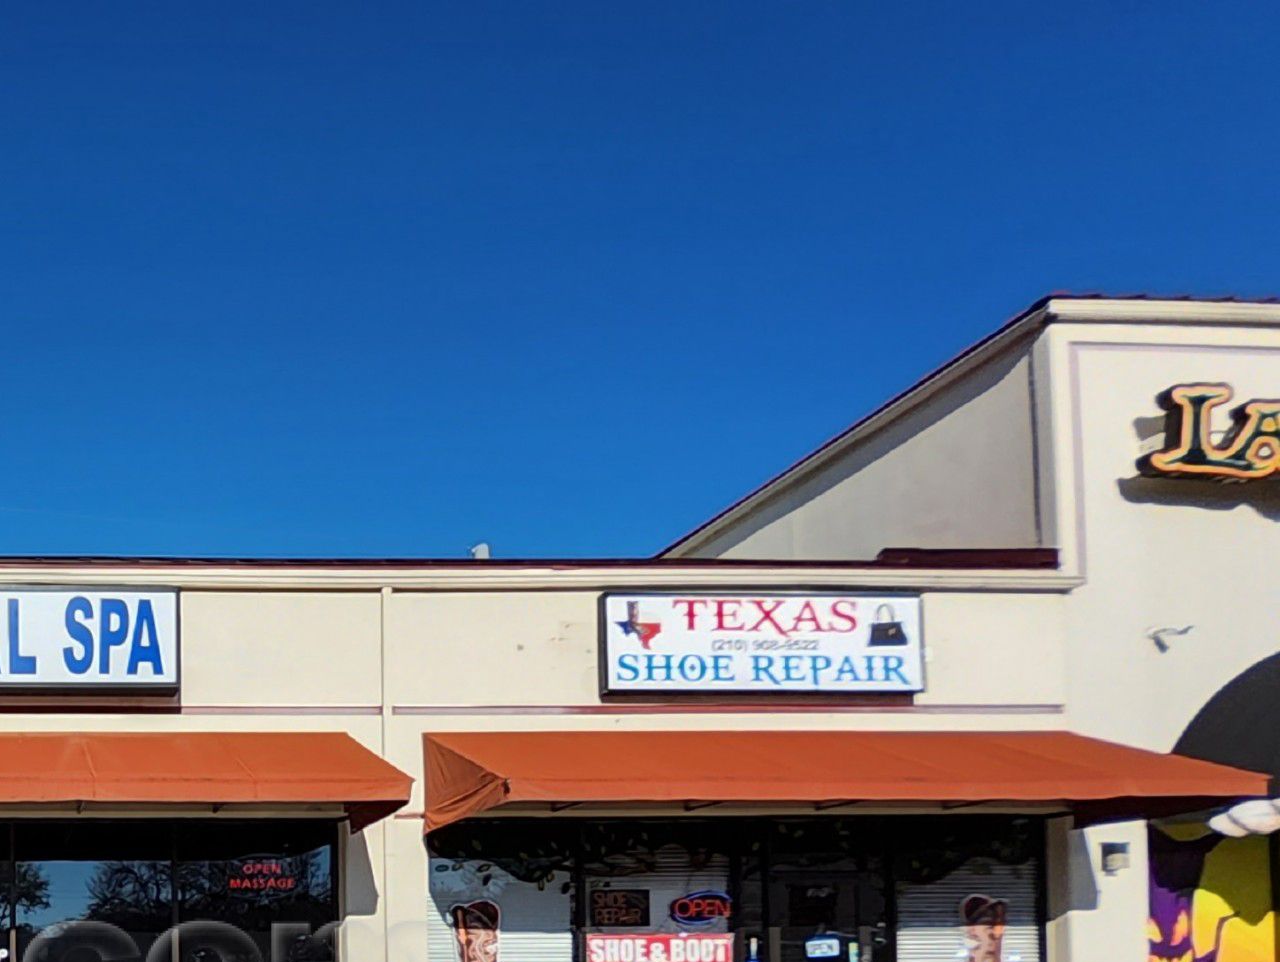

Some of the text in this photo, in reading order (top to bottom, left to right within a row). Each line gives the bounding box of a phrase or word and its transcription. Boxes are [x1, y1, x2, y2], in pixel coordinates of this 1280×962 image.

[672, 599, 858, 637] TEXAS
[62, 595, 165, 676] SPA
[616, 653, 911, 686] SHOE REPAIR
[242, 863, 282, 875] OPEN
[229, 878, 296, 890] MASSAGE
[674, 898, 731, 918] OPEN
[589, 938, 729, 962] SHOE & BOOT
